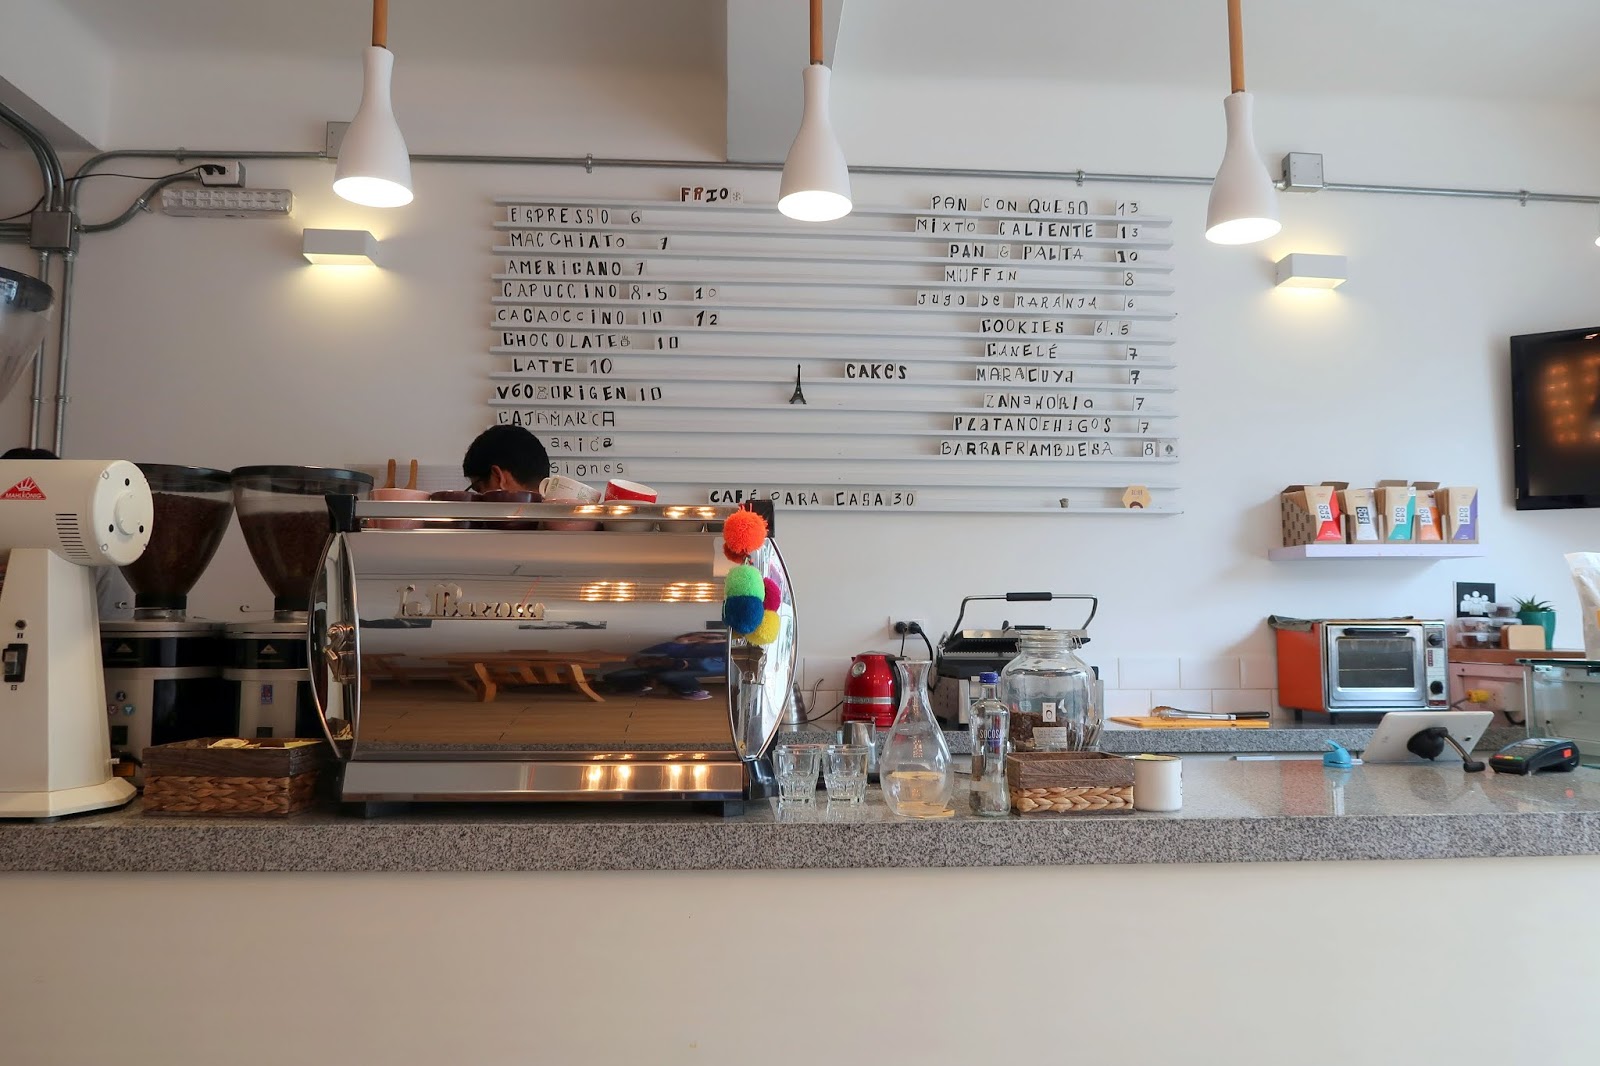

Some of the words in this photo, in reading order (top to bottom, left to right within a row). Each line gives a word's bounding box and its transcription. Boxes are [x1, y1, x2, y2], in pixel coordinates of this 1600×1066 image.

[681, 187, 729, 203] FRIO
[932, 195, 968, 211] PAN
[983, 197, 1018, 212] CON
[1028, 198, 1089, 216] QUESO
[1117, 203, 1139, 217] 13
[511, 208, 609, 224] ESPRESSO
[630, 210, 642, 224] 6
[1121, 226, 1139, 239] 13
[950, 244, 985, 258] PAN
[1022, 245, 1084, 260] PALTA
[1117, 250, 1138, 263] 10
[945, 267, 1018, 282] MUFFIN
[1124, 272, 1134, 286] 8
[1126, 298, 1134, 309] 6
[641, 310, 663, 324] 10
[696, 310, 718, 326] 12
[981, 318, 1064, 334] COOKIES
[503, 332, 618, 349] CHOCOLATE
[657, 336, 679, 350] 10
[986, 343, 1058, 359] CANELÉ
[1128, 347, 1139, 360] 7
[513, 358, 575, 373] LATTE
[589, 358, 613, 374] 10
[1129, 370, 1141, 384] 7
[1135, 397, 1145, 411] 7
[498, 410, 615, 426] CAJAMARCA
[1140, 422, 1150, 434] 7
[941, 441, 1114, 457] BARRAFRAMBUESA
[1144, 442, 1154, 455] 8
[549, 462, 624, 476] siones
[836, 492, 884, 506] CASA
